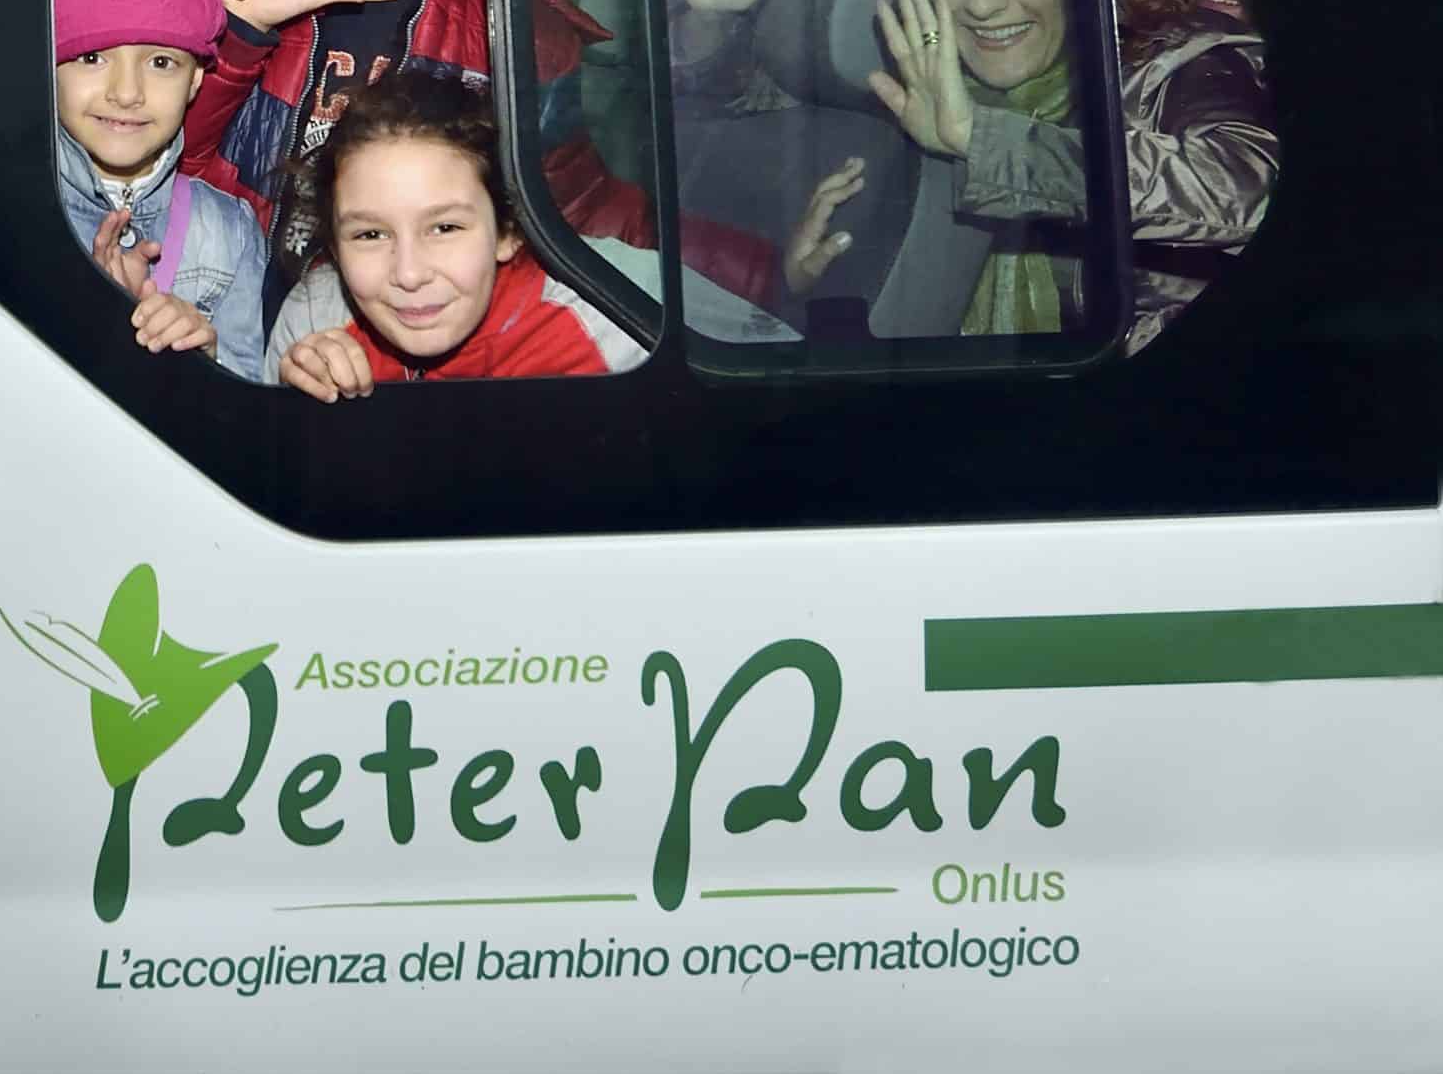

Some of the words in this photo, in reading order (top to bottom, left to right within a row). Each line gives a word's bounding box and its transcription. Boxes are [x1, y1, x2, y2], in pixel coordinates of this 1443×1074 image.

[294, 647, 609, 690] Associazione
[93, 662, 602, 923] Peter
[641, 638, 1067, 912] Pan
[932, 862, 1065, 905] Onlus
[95, 945, 387, 997] L'accoglienza
[399, 941, 465, 982] del
[476, 937, 669, 978] bambino
[683, 926, 1080, 977] onco-ematologico
